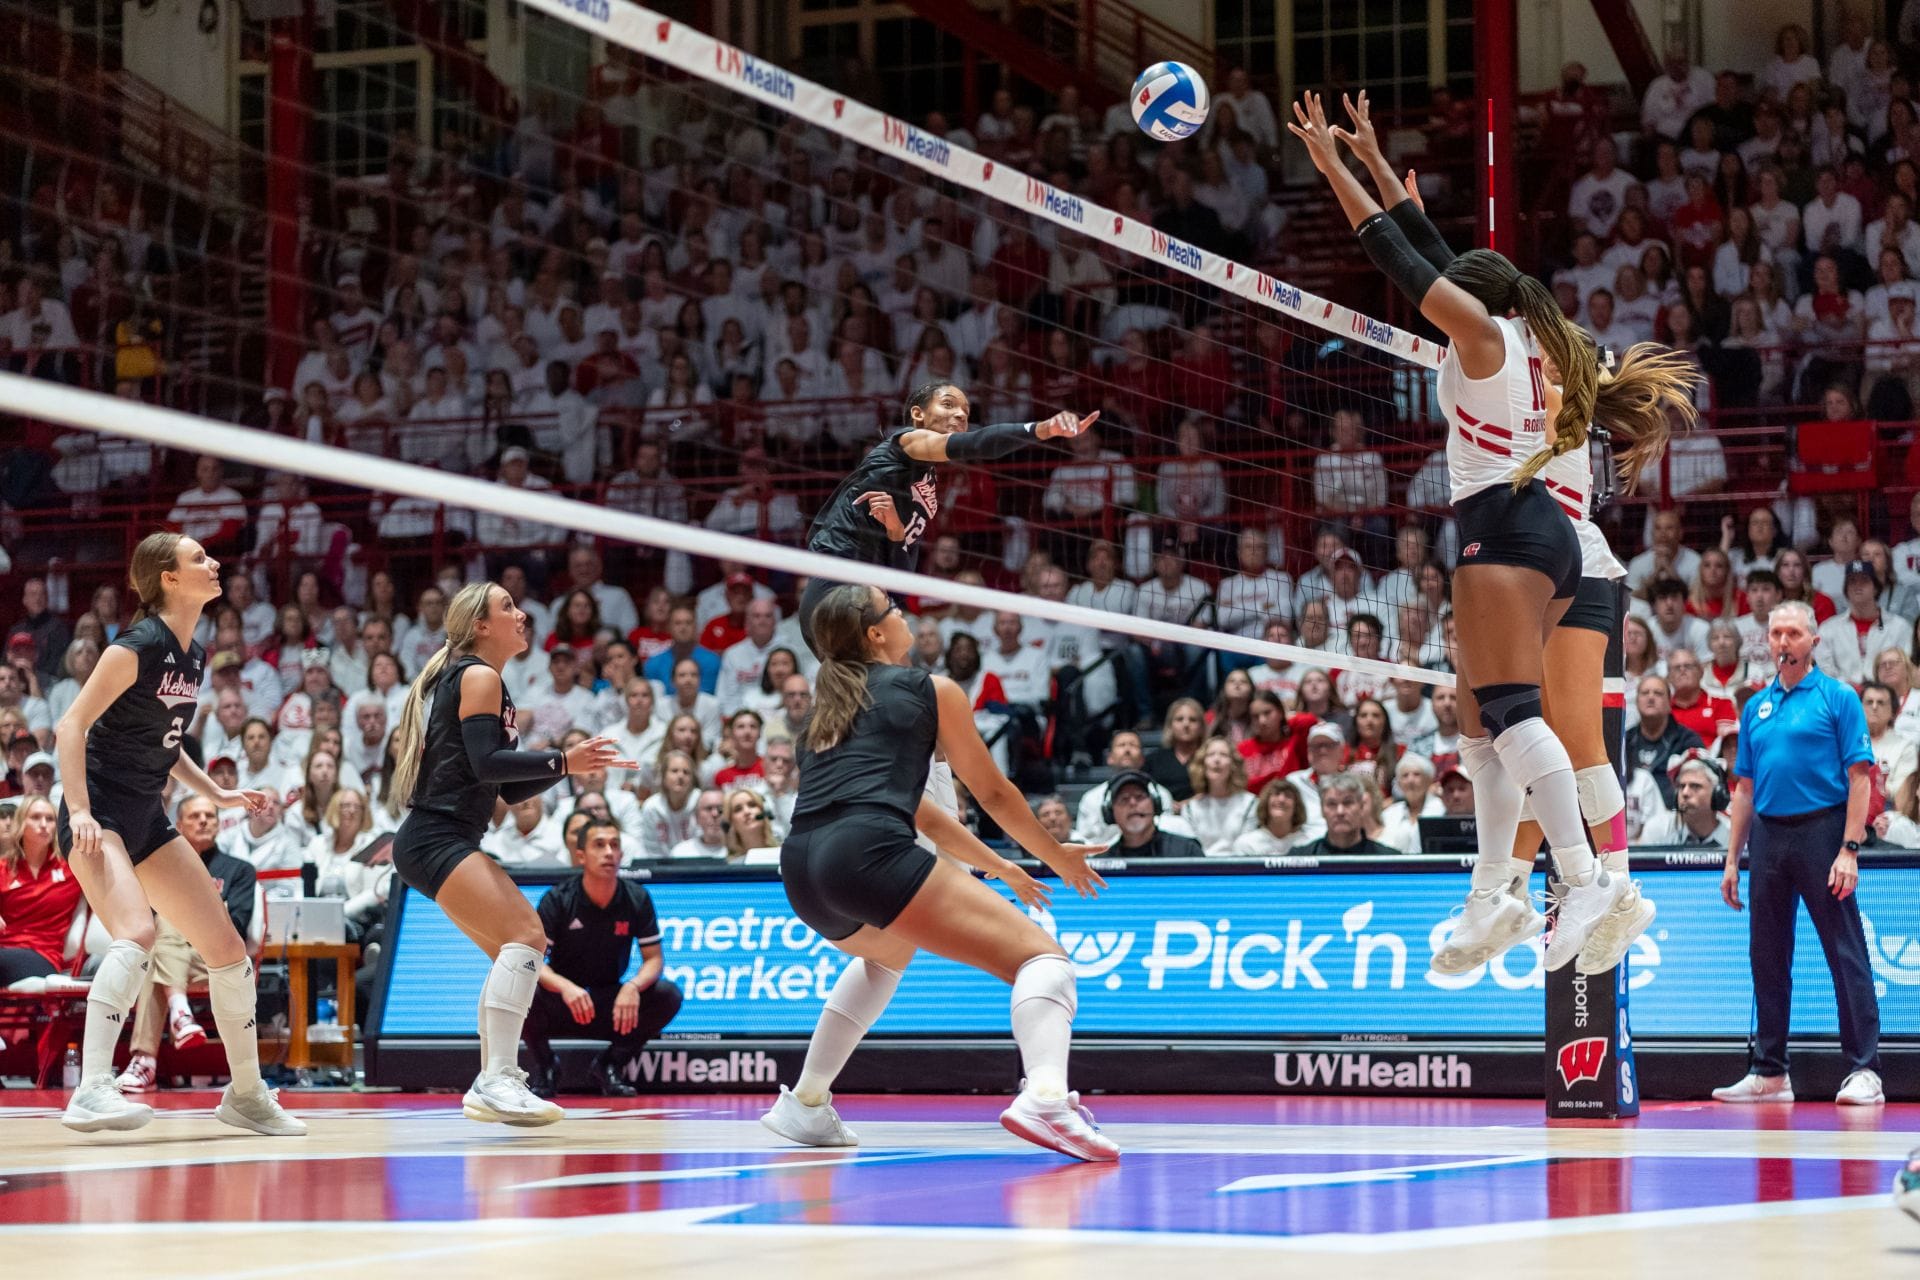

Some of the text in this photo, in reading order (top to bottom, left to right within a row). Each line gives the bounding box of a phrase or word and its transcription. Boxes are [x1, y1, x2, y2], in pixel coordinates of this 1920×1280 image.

[902, 511, 926, 553] 12
[162, 716, 184, 749] 2
[1665, 853, 1723, 865] UWHealth
[657, 908, 818, 952] metro
[1141, 918, 1333, 990] Pick
[1424, 918, 1661, 991] Sae
[1341, 1034, 1408, 1042] DAKTRONICS
[626, 1051, 777, 1083] WHealth
[1274, 1053, 1472, 1089] UWHealth
[1556, 1037, 1608, 1092] W
[1558, 1101, 1574, 1109] (800)
